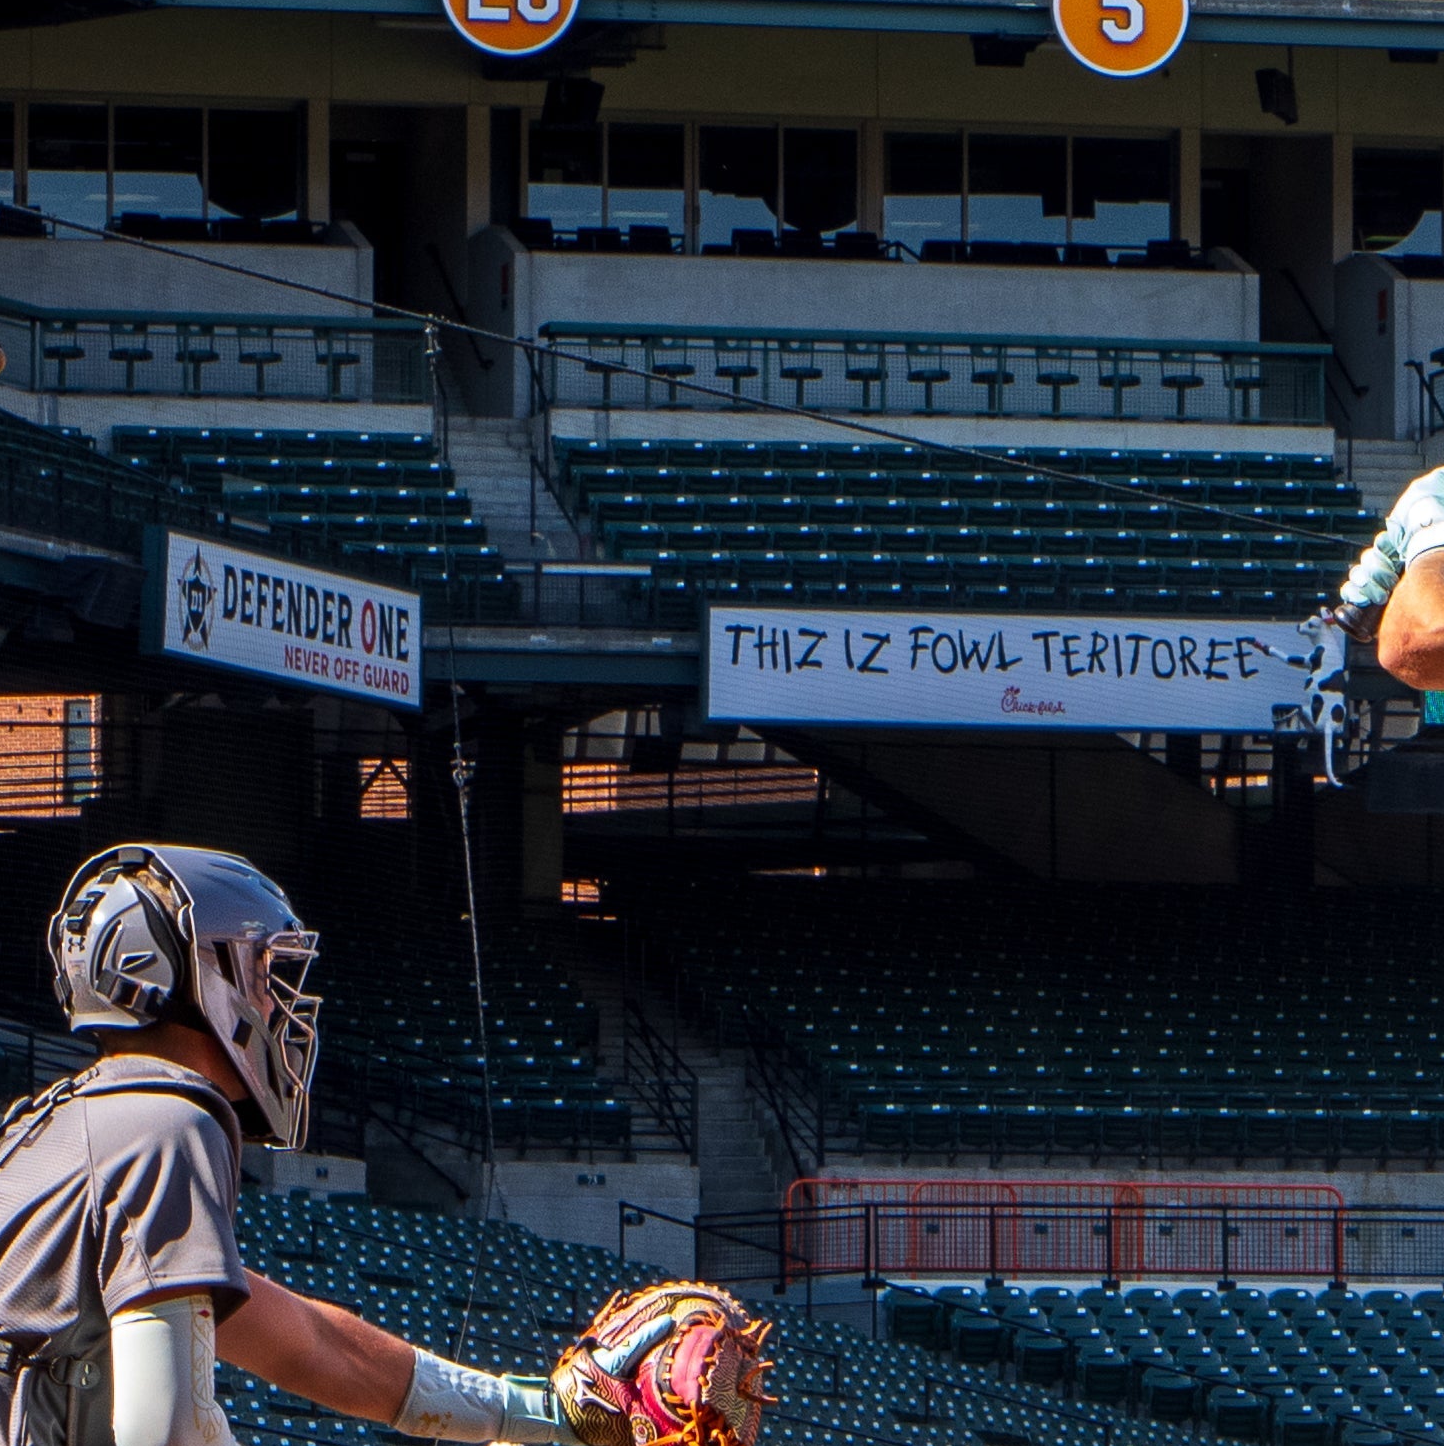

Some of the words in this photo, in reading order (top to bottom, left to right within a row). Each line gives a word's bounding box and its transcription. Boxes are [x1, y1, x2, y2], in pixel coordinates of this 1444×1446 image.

[222, 563, 353, 649] DEFENDER
[359, 598, 410, 663] ONE
[284, 644, 329, 677] NEVER
[333, 657, 360, 684] OFF
[363, 664, 410, 696] GUARD
[725, 624, 829, 674] THIZ
[844, 626, 892, 674] IZ
[909, 625, 1023, 674] FOWL
[1031, 630, 1261, 680] TERITOREE
